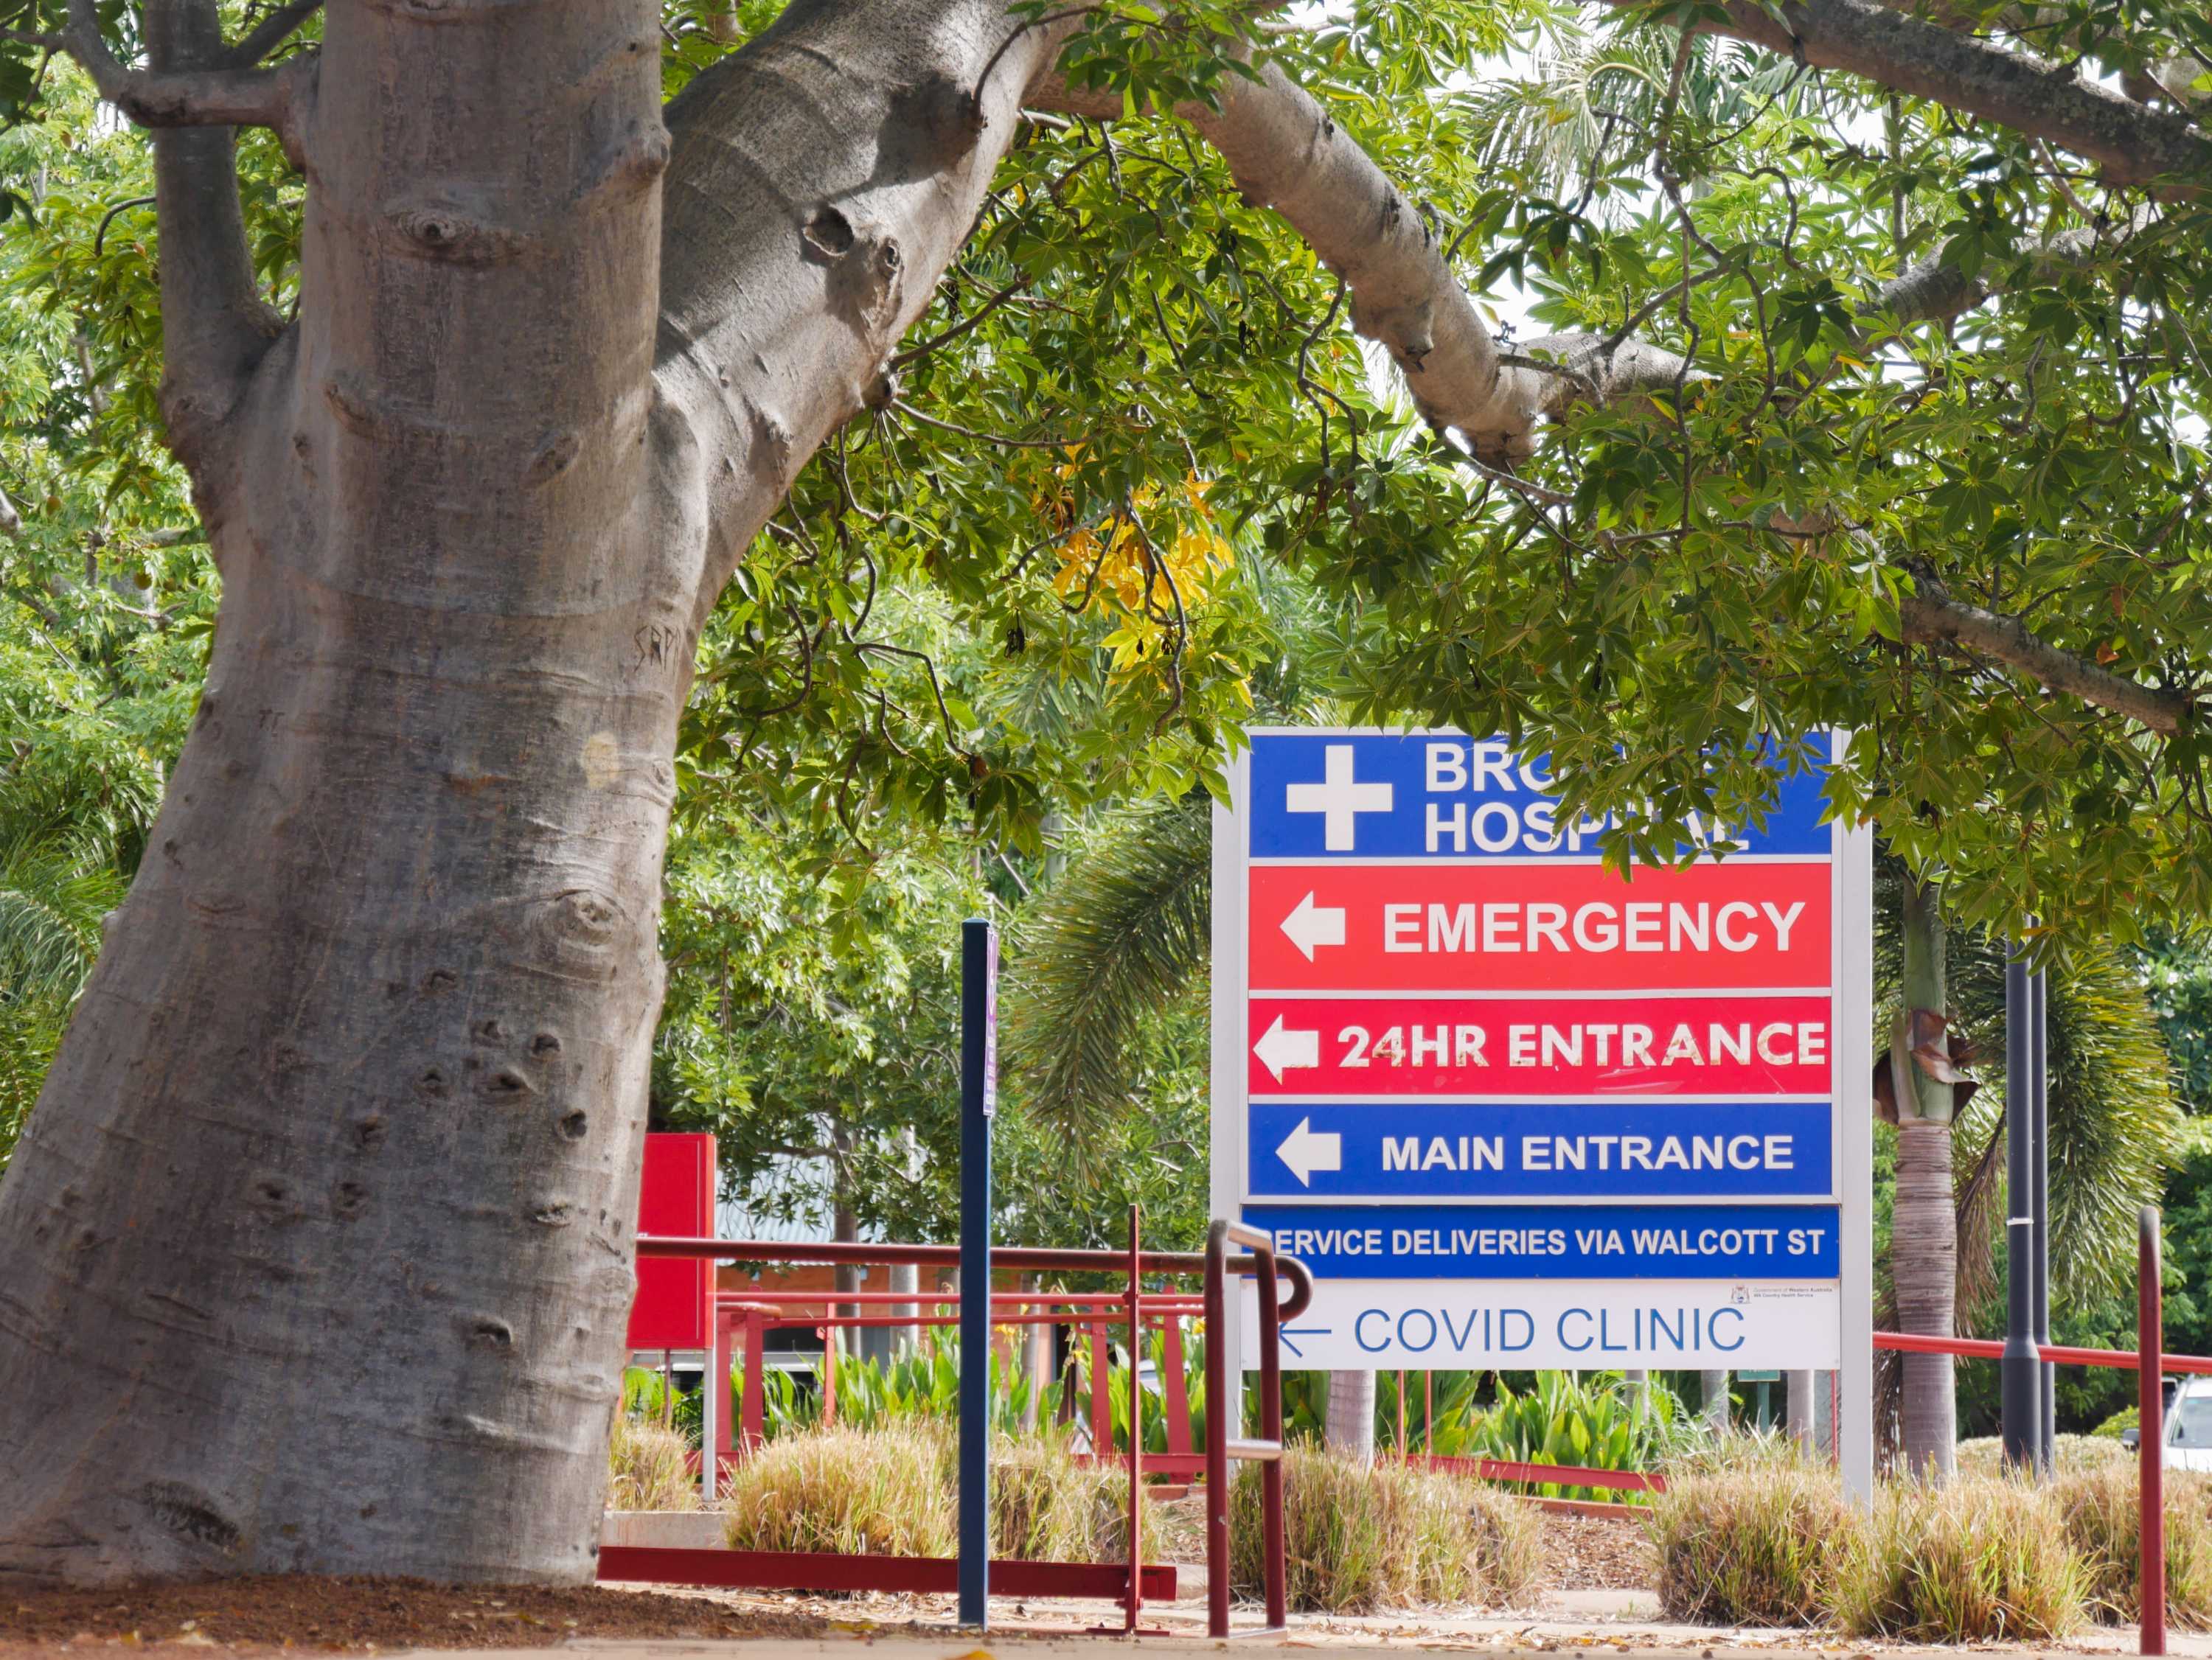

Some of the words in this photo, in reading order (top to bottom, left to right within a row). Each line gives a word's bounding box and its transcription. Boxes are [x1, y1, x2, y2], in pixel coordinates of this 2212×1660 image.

[1384, 902, 1806, 953] EMERGENCY
[1338, 1025, 1489, 1067] 24HR
[1509, 1023, 1825, 1067] ENTRANCE
[1382, 1136, 1503, 1171] MAIN
[1522, 1135, 1793, 1171] ENTRANCE
[1275, 1230, 1382, 1255] ERVICE
[1392, 1230, 1566, 1255] DELIVERIES
[1575, 1230, 1625, 1255] VIA
[1631, 1230, 1778, 1255] WALCOTT
[1787, 1230, 1825, 1255] ST
[1354, 1308, 1535, 1352] COVID
[1557, 1308, 1745, 1352] CLINIC
